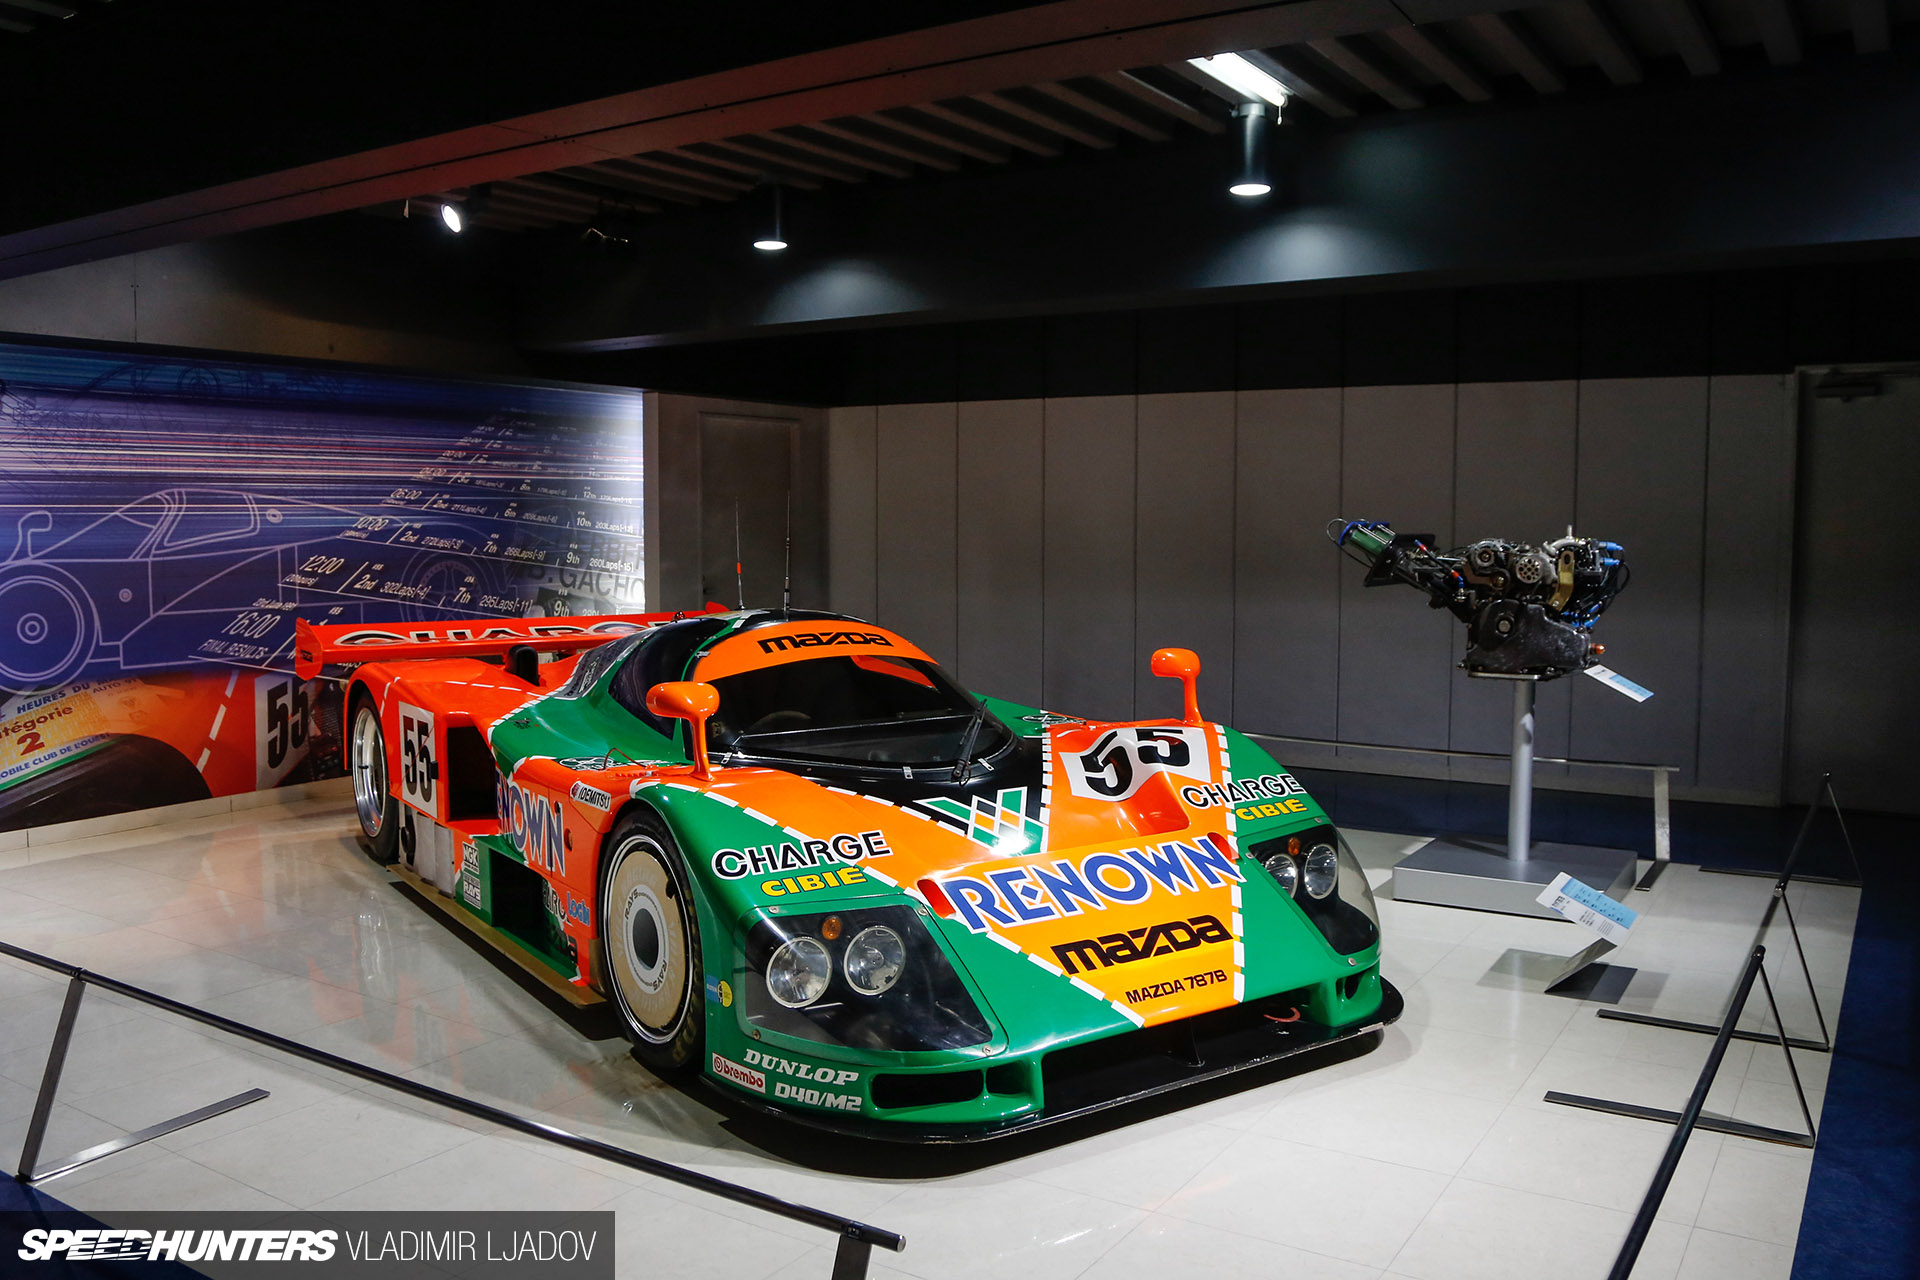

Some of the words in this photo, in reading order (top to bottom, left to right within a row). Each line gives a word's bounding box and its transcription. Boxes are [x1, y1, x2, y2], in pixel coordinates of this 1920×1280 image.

[390, 488, 422, 499] 06:00
[352, 516, 389, 531] 10:00
[400, 531, 420, 543] 2nd
[299, 554, 344, 575] 12:00
[566, 551, 580, 564] 9th
[353, 573, 379, 590] 2nd
[454, 587, 472, 605] 7th
[553, 600, 570, 617] 9th
[221, 610, 281, 638] 16:00
[198, 638, 229, 654] FINAL
[223, 643, 269, 660] RESULTS
[17, 690, 66, 715] HEURES
[72, 682, 90, 693] DU
[0, 705, 73, 738] tégorie
[267, 681, 309, 769] 55
[17, 731, 45, 756] 2
[0, 762, 30, 779] OBILE
[32, 751, 58, 766] CLUB
[59, 744, 73, 755] DE
[403, 715, 433, 803] 55
[1080, 728, 1191, 797] 55
[579, 786, 610, 809] IDEMITSU
[1181, 773, 1304, 809] CHARGE
[463, 843, 478, 867] NGK
[711, 830, 893, 880] CHARGE
[941, 836, 1246, 934] RENOWN
[624, 888, 639, 920] RAYS
[652, 959, 668, 991] RAYS
[1126, 980, 1187, 1004] MAZDA
[1184, 969, 1228, 992] 787B
[722, 1059, 764, 1089] brembo
[743, 1048, 859, 1086] DUNLOP
[774, 1082, 862, 1112] D40/M2
